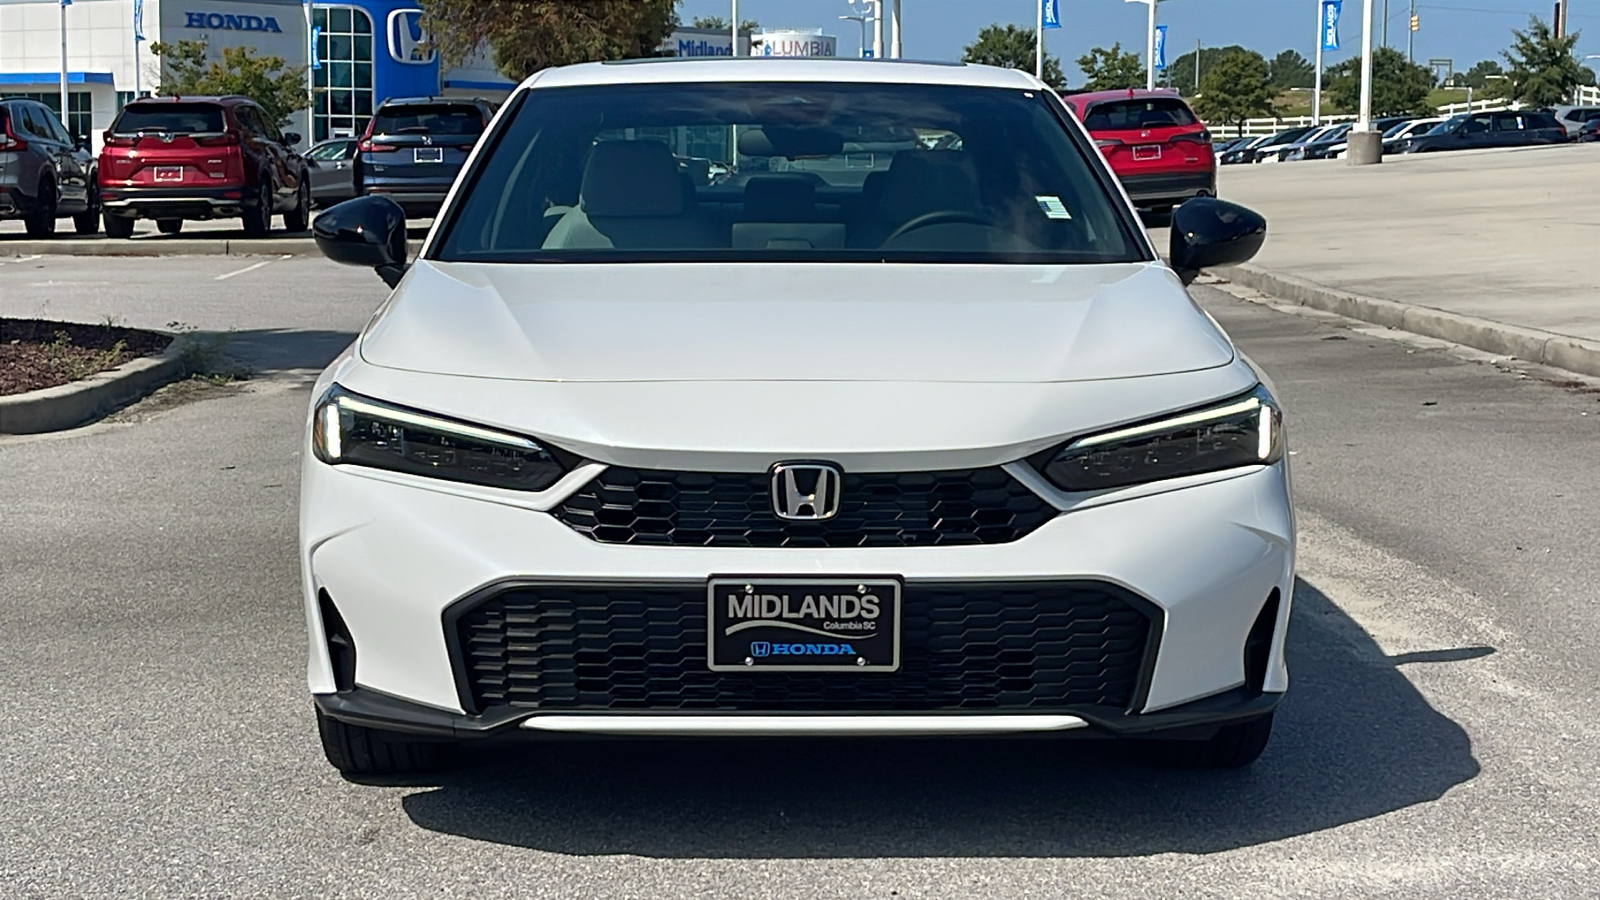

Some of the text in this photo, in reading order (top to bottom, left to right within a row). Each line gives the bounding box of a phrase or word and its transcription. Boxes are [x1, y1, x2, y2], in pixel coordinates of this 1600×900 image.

[184, 11, 283, 33] HONDA
[679, 39, 734, 57] Midland
[764, 39, 833, 57] LUMBIA
[727, 594, 880, 619] MIDLANDS
[823, 621, 876, 630] Columbia SC
[772, 644, 857, 655] HONDA
